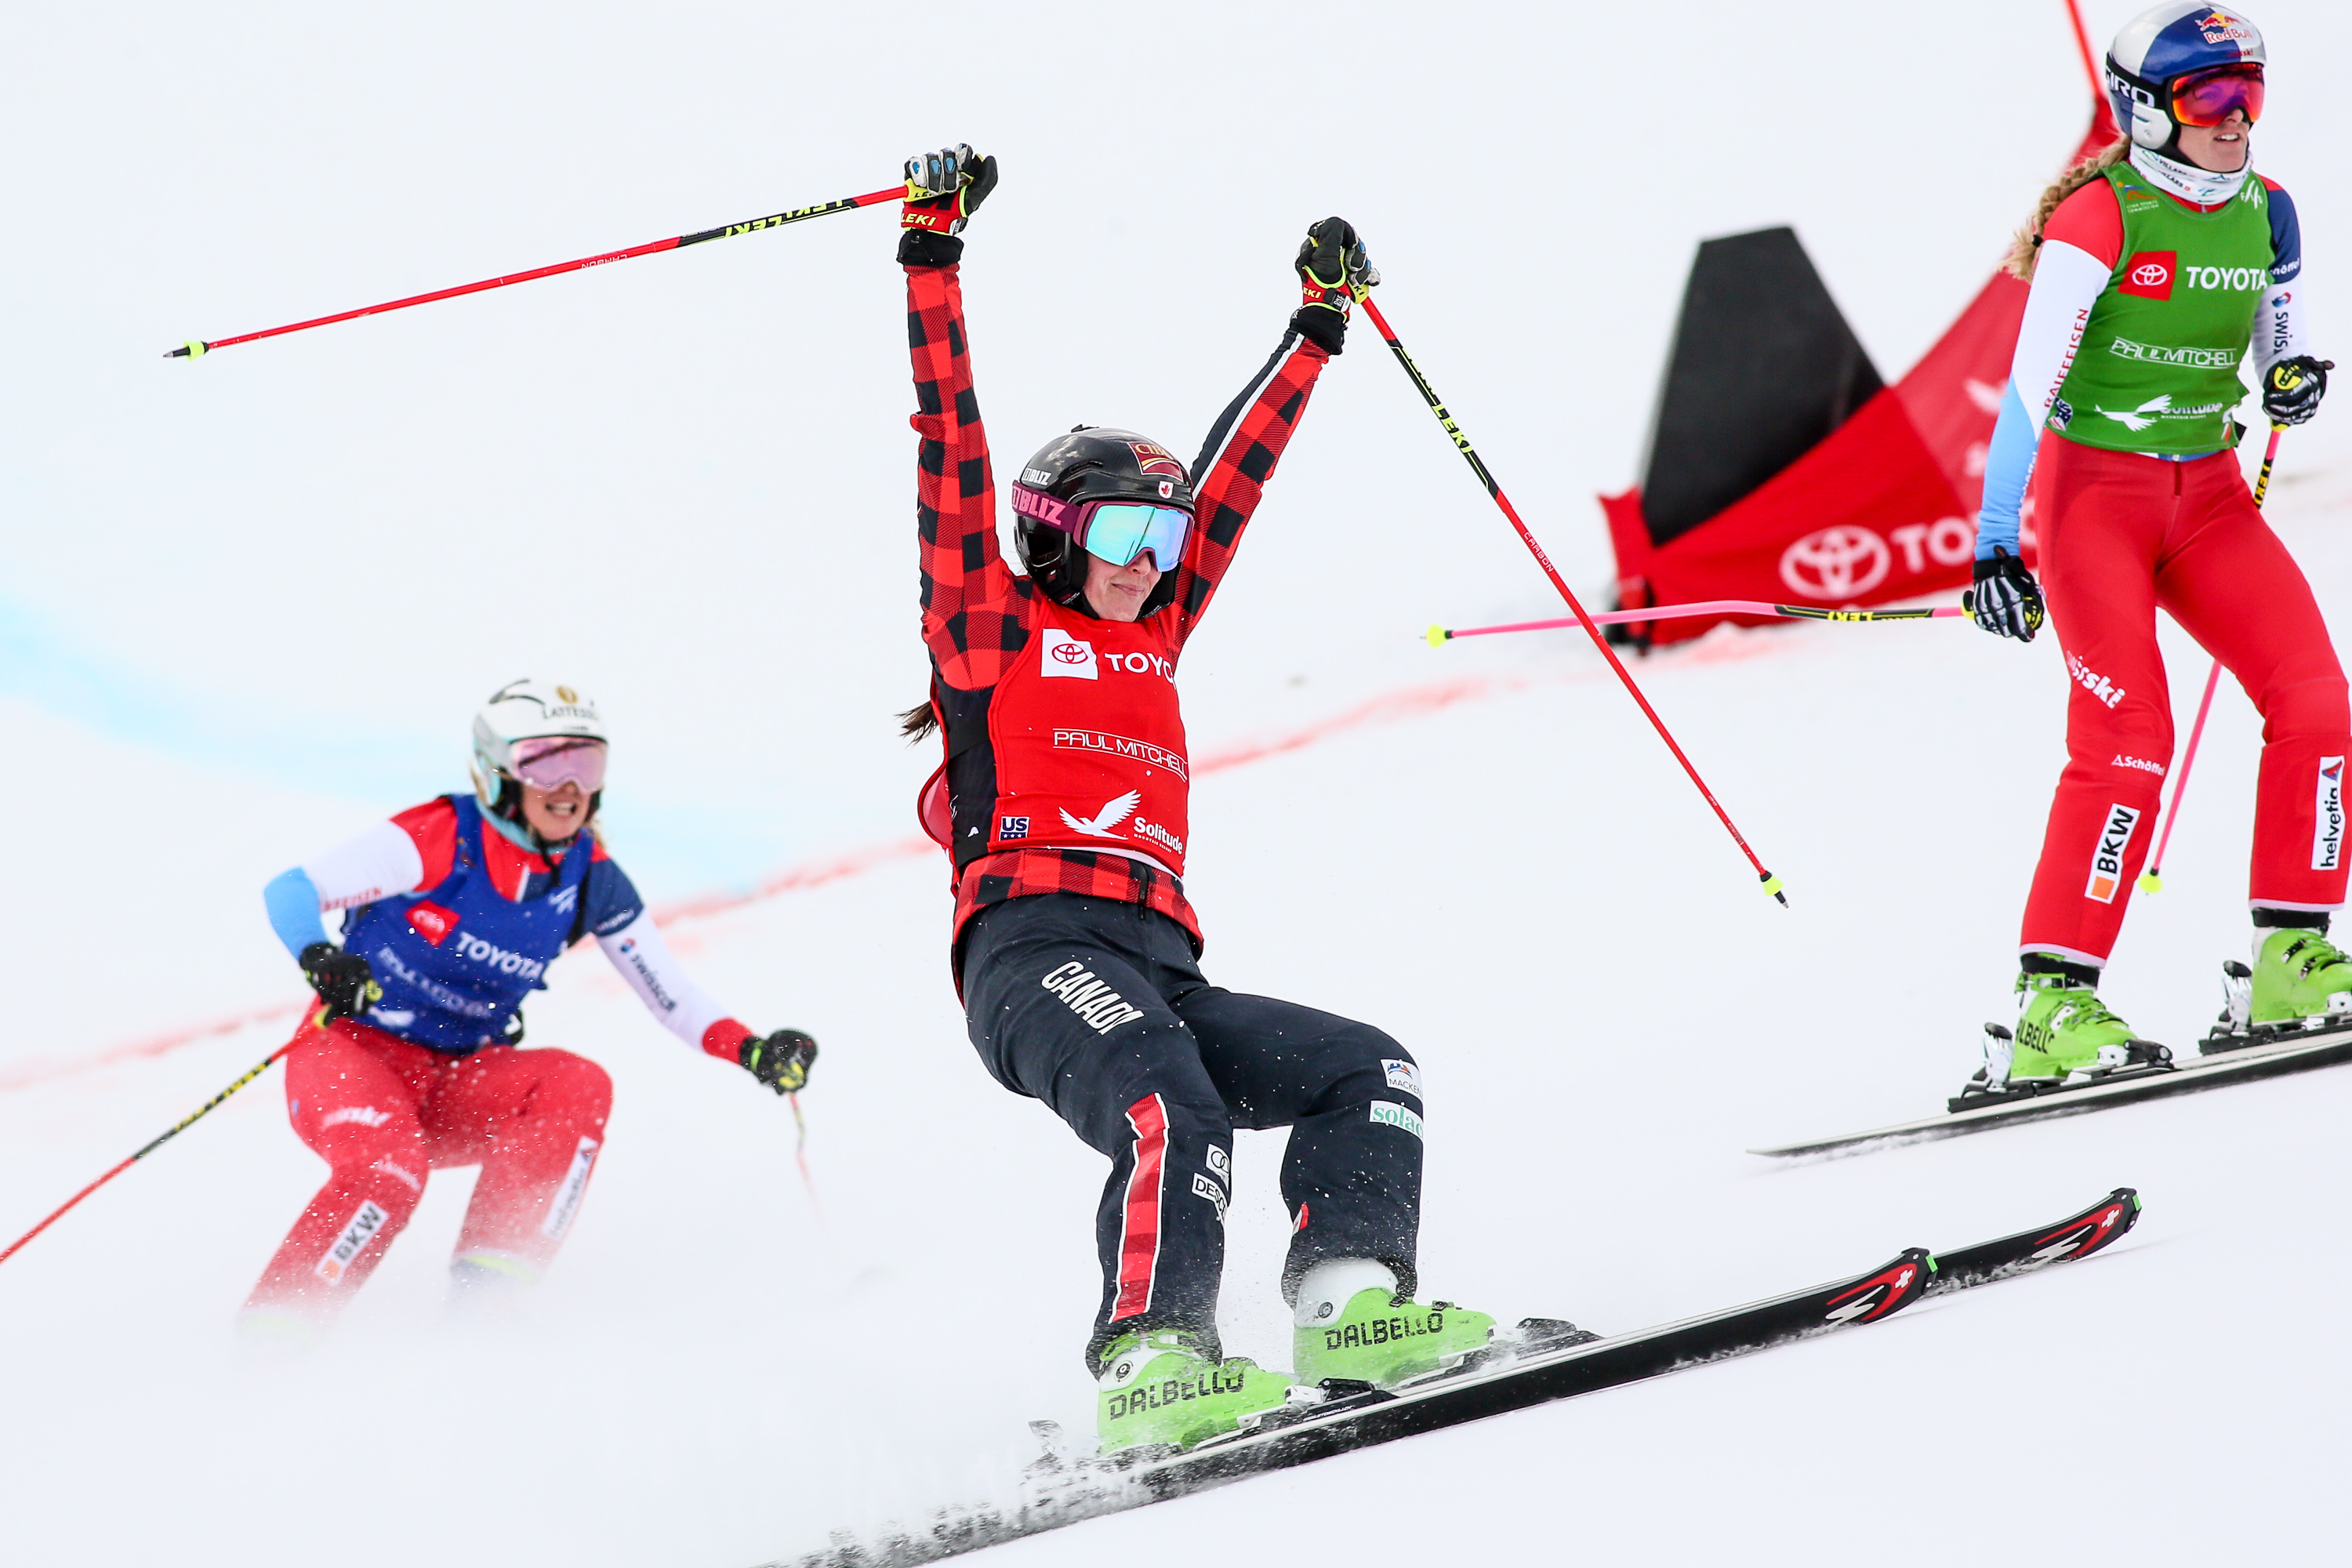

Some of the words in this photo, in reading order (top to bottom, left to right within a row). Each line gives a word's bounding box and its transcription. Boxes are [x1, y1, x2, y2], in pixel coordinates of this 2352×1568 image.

[2204, 27, 2231, 43] Red
[724, 215, 782, 238] LEKI
[902, 212, 937, 227] LEKI
[1302, 287, 1322, 299] EKI
[2186, 266, 2268, 291] TOYOTA
[2111, 340, 2161, 361] PAUL
[2162, 347, 2234, 367] MITCHELL
[1432, 402, 1473, 453] LEKI
[1524, 532, 1554, 572] CARBON
[1054, 731, 1114, 751] PAUL
[1116, 739, 1186, 779] MITCHELL
[1002, 817, 1028, 832] US
[1133, 816, 1184, 855] Solitude
[2096, 808, 2134, 875] BKW
[2320, 787, 2340, 868] helvetia
[456, 932, 544, 980] TOYOTA
[1195, 1178, 1226, 1215] DESC
[1323, 1312, 1444, 1350] DALBELLO
[1108, 1370, 1244, 1421] DALBELLO
